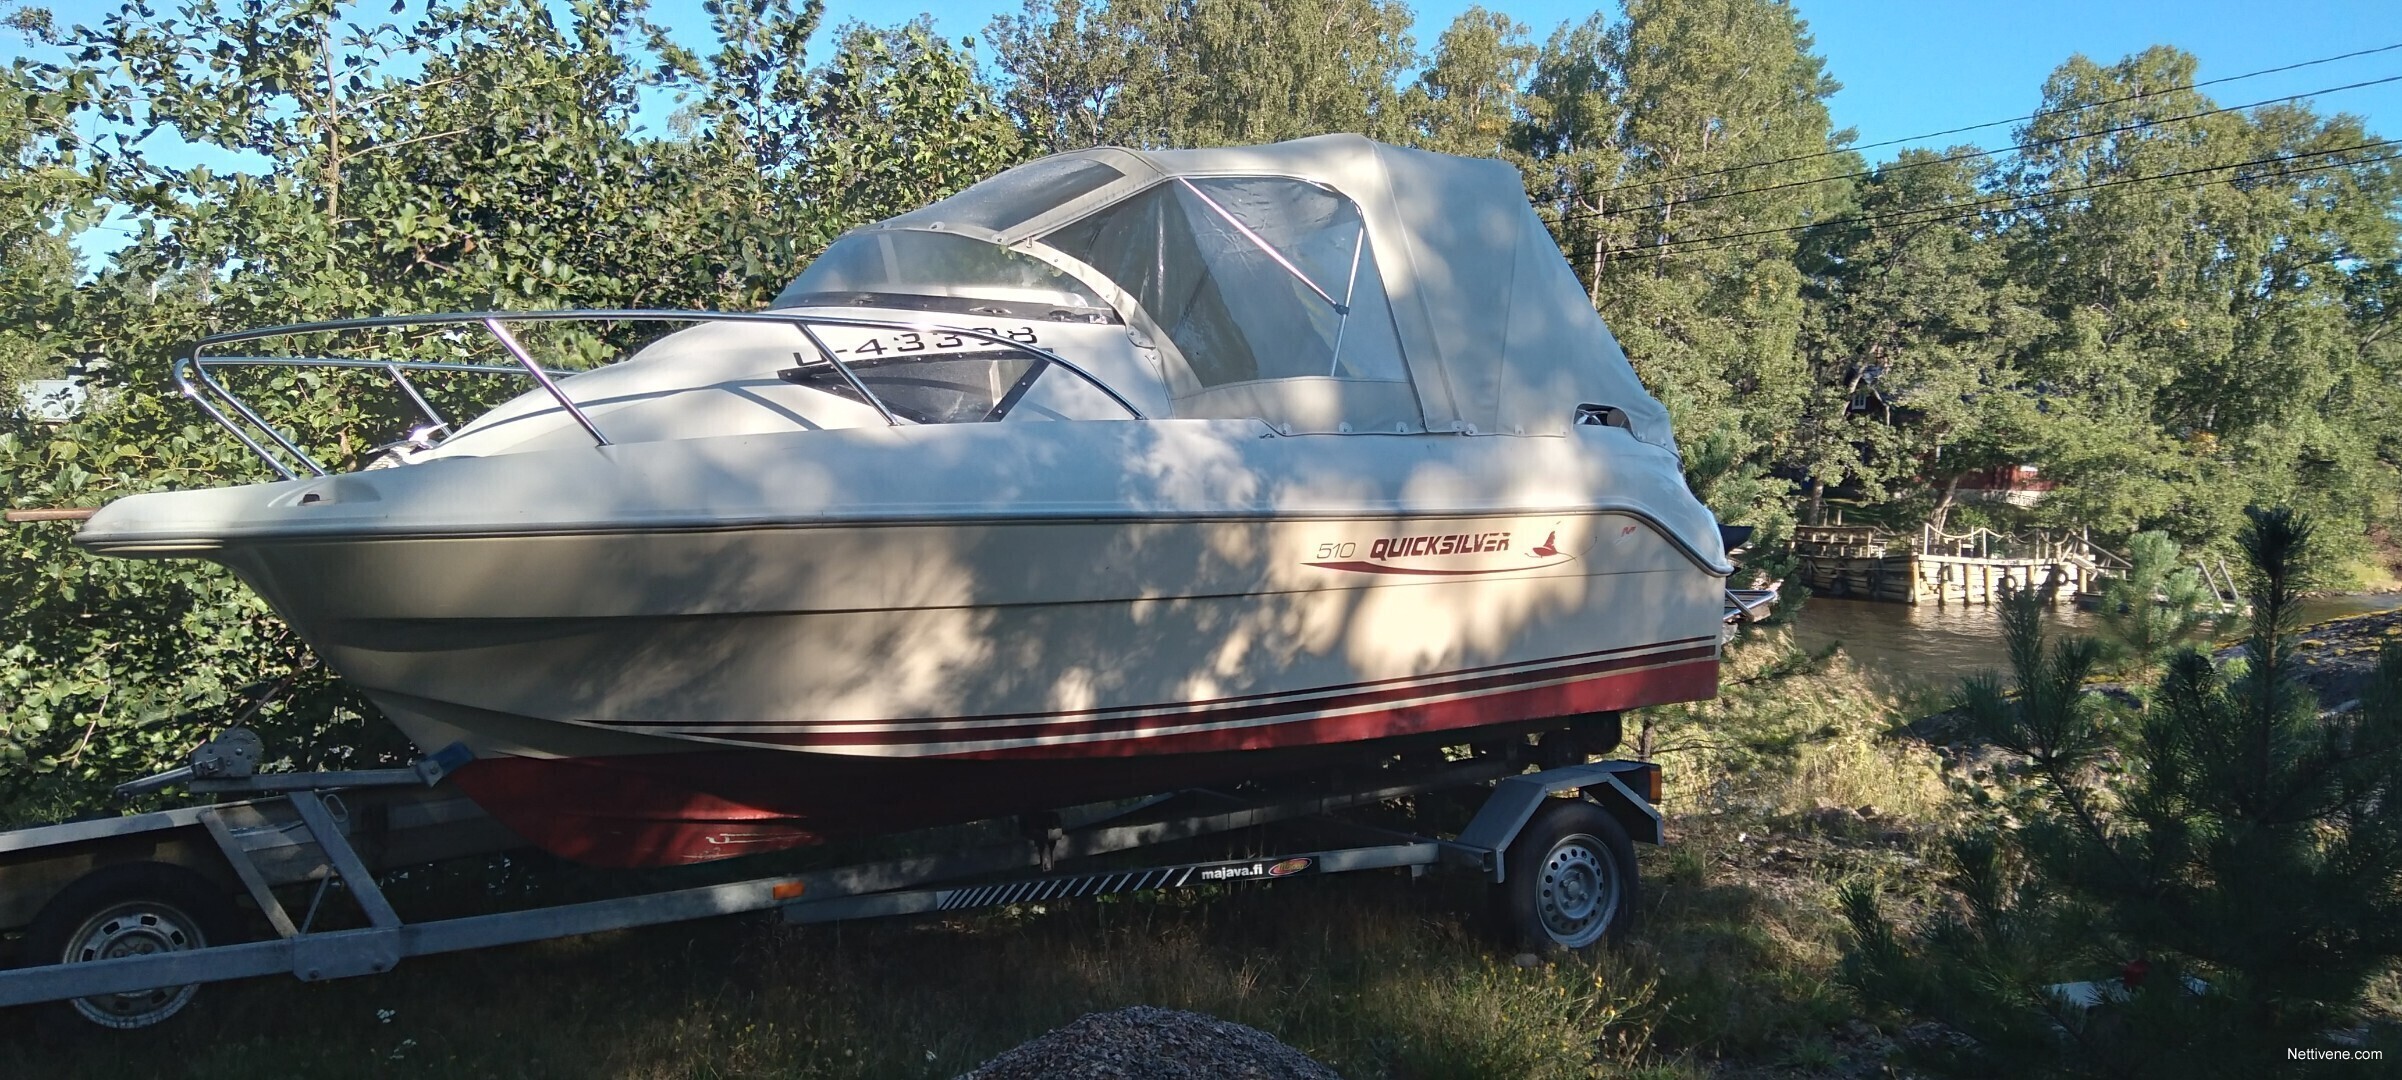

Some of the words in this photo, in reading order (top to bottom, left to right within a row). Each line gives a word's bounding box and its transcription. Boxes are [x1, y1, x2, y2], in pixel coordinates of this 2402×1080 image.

[1316, 542, 1356, 559] 510
[1369, 532, 1511, 561] QUICKSILVER
[1201, 863, 1263, 880] majava.fi
